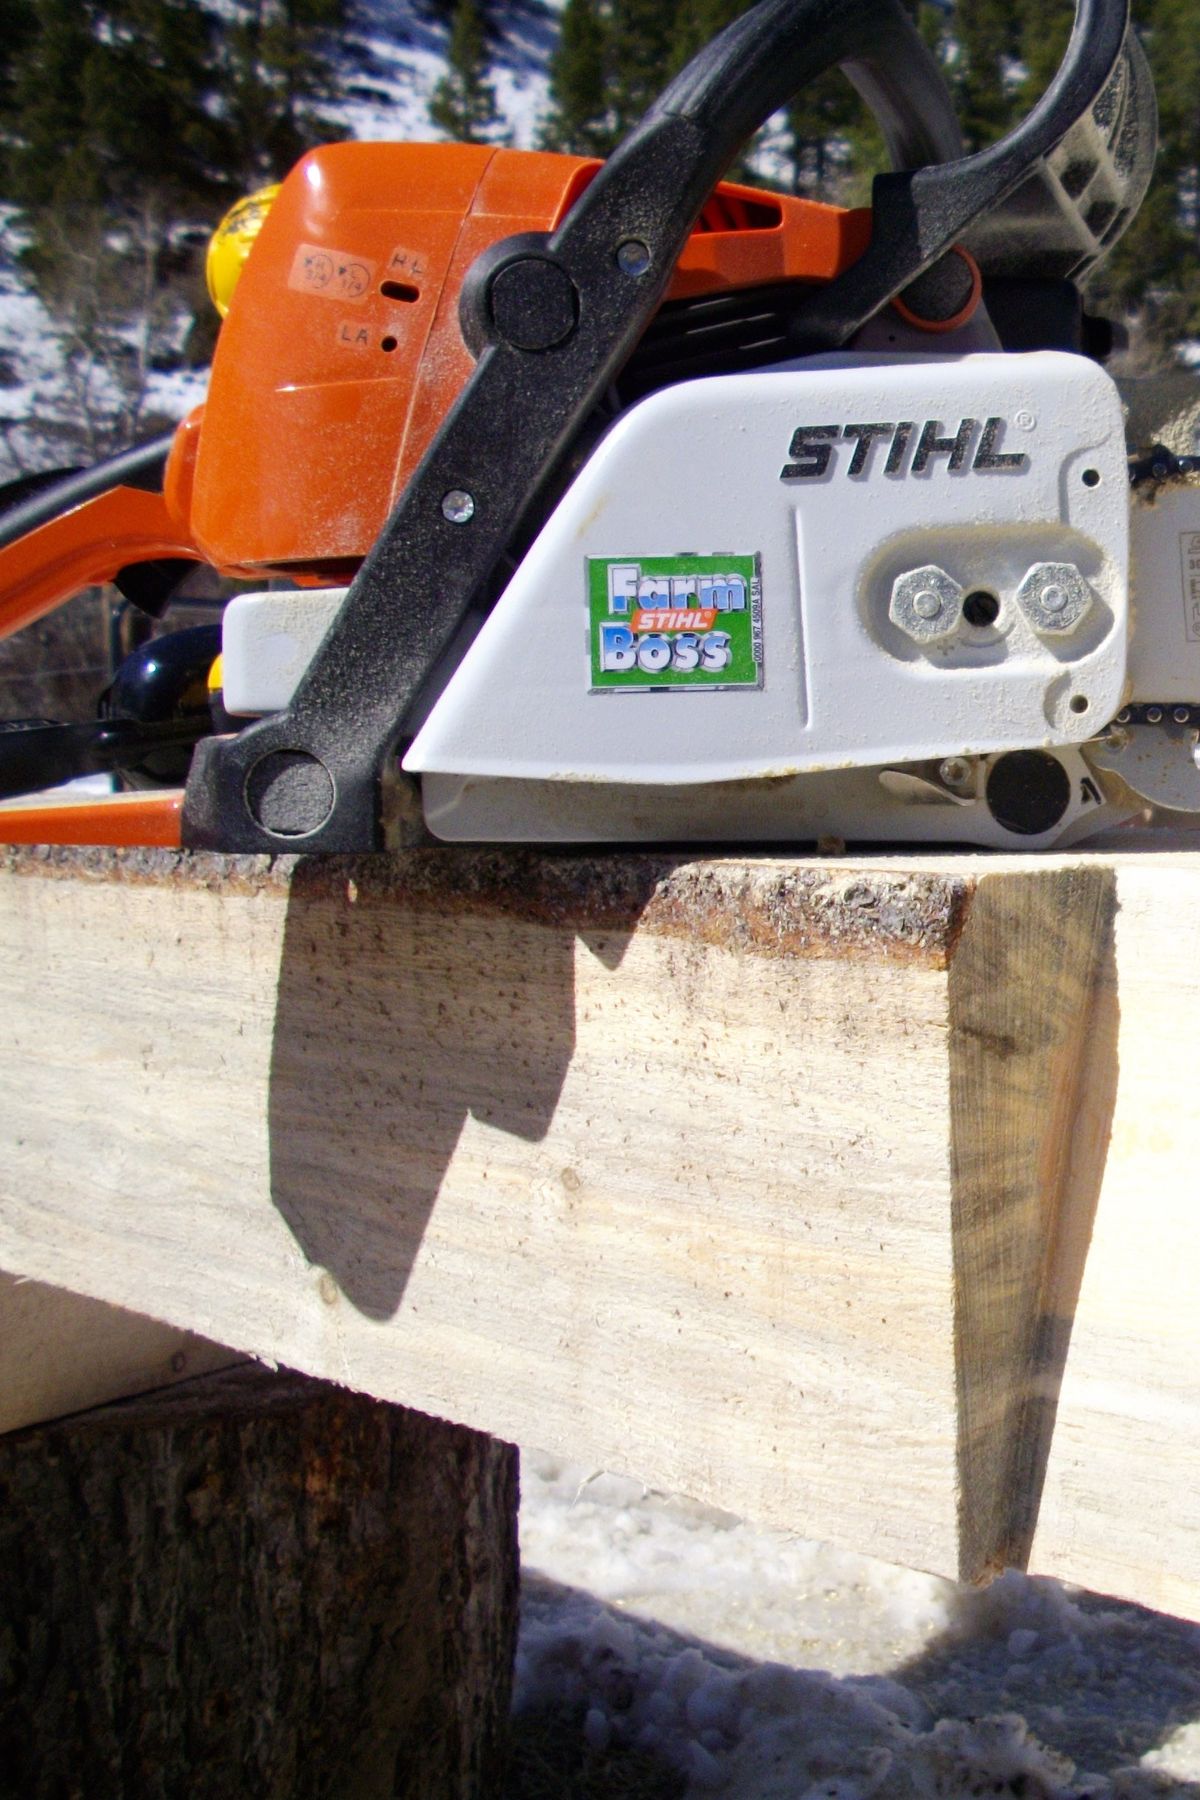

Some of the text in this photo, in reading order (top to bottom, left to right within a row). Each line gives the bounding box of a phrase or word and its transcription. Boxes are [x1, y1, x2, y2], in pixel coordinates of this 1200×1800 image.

[779, 416, 1026, 479] STIHL
[607, 563, 748, 614] Farm
[637, 612, 708, 630] STIHL
[600, 622, 733, 673] Boss
